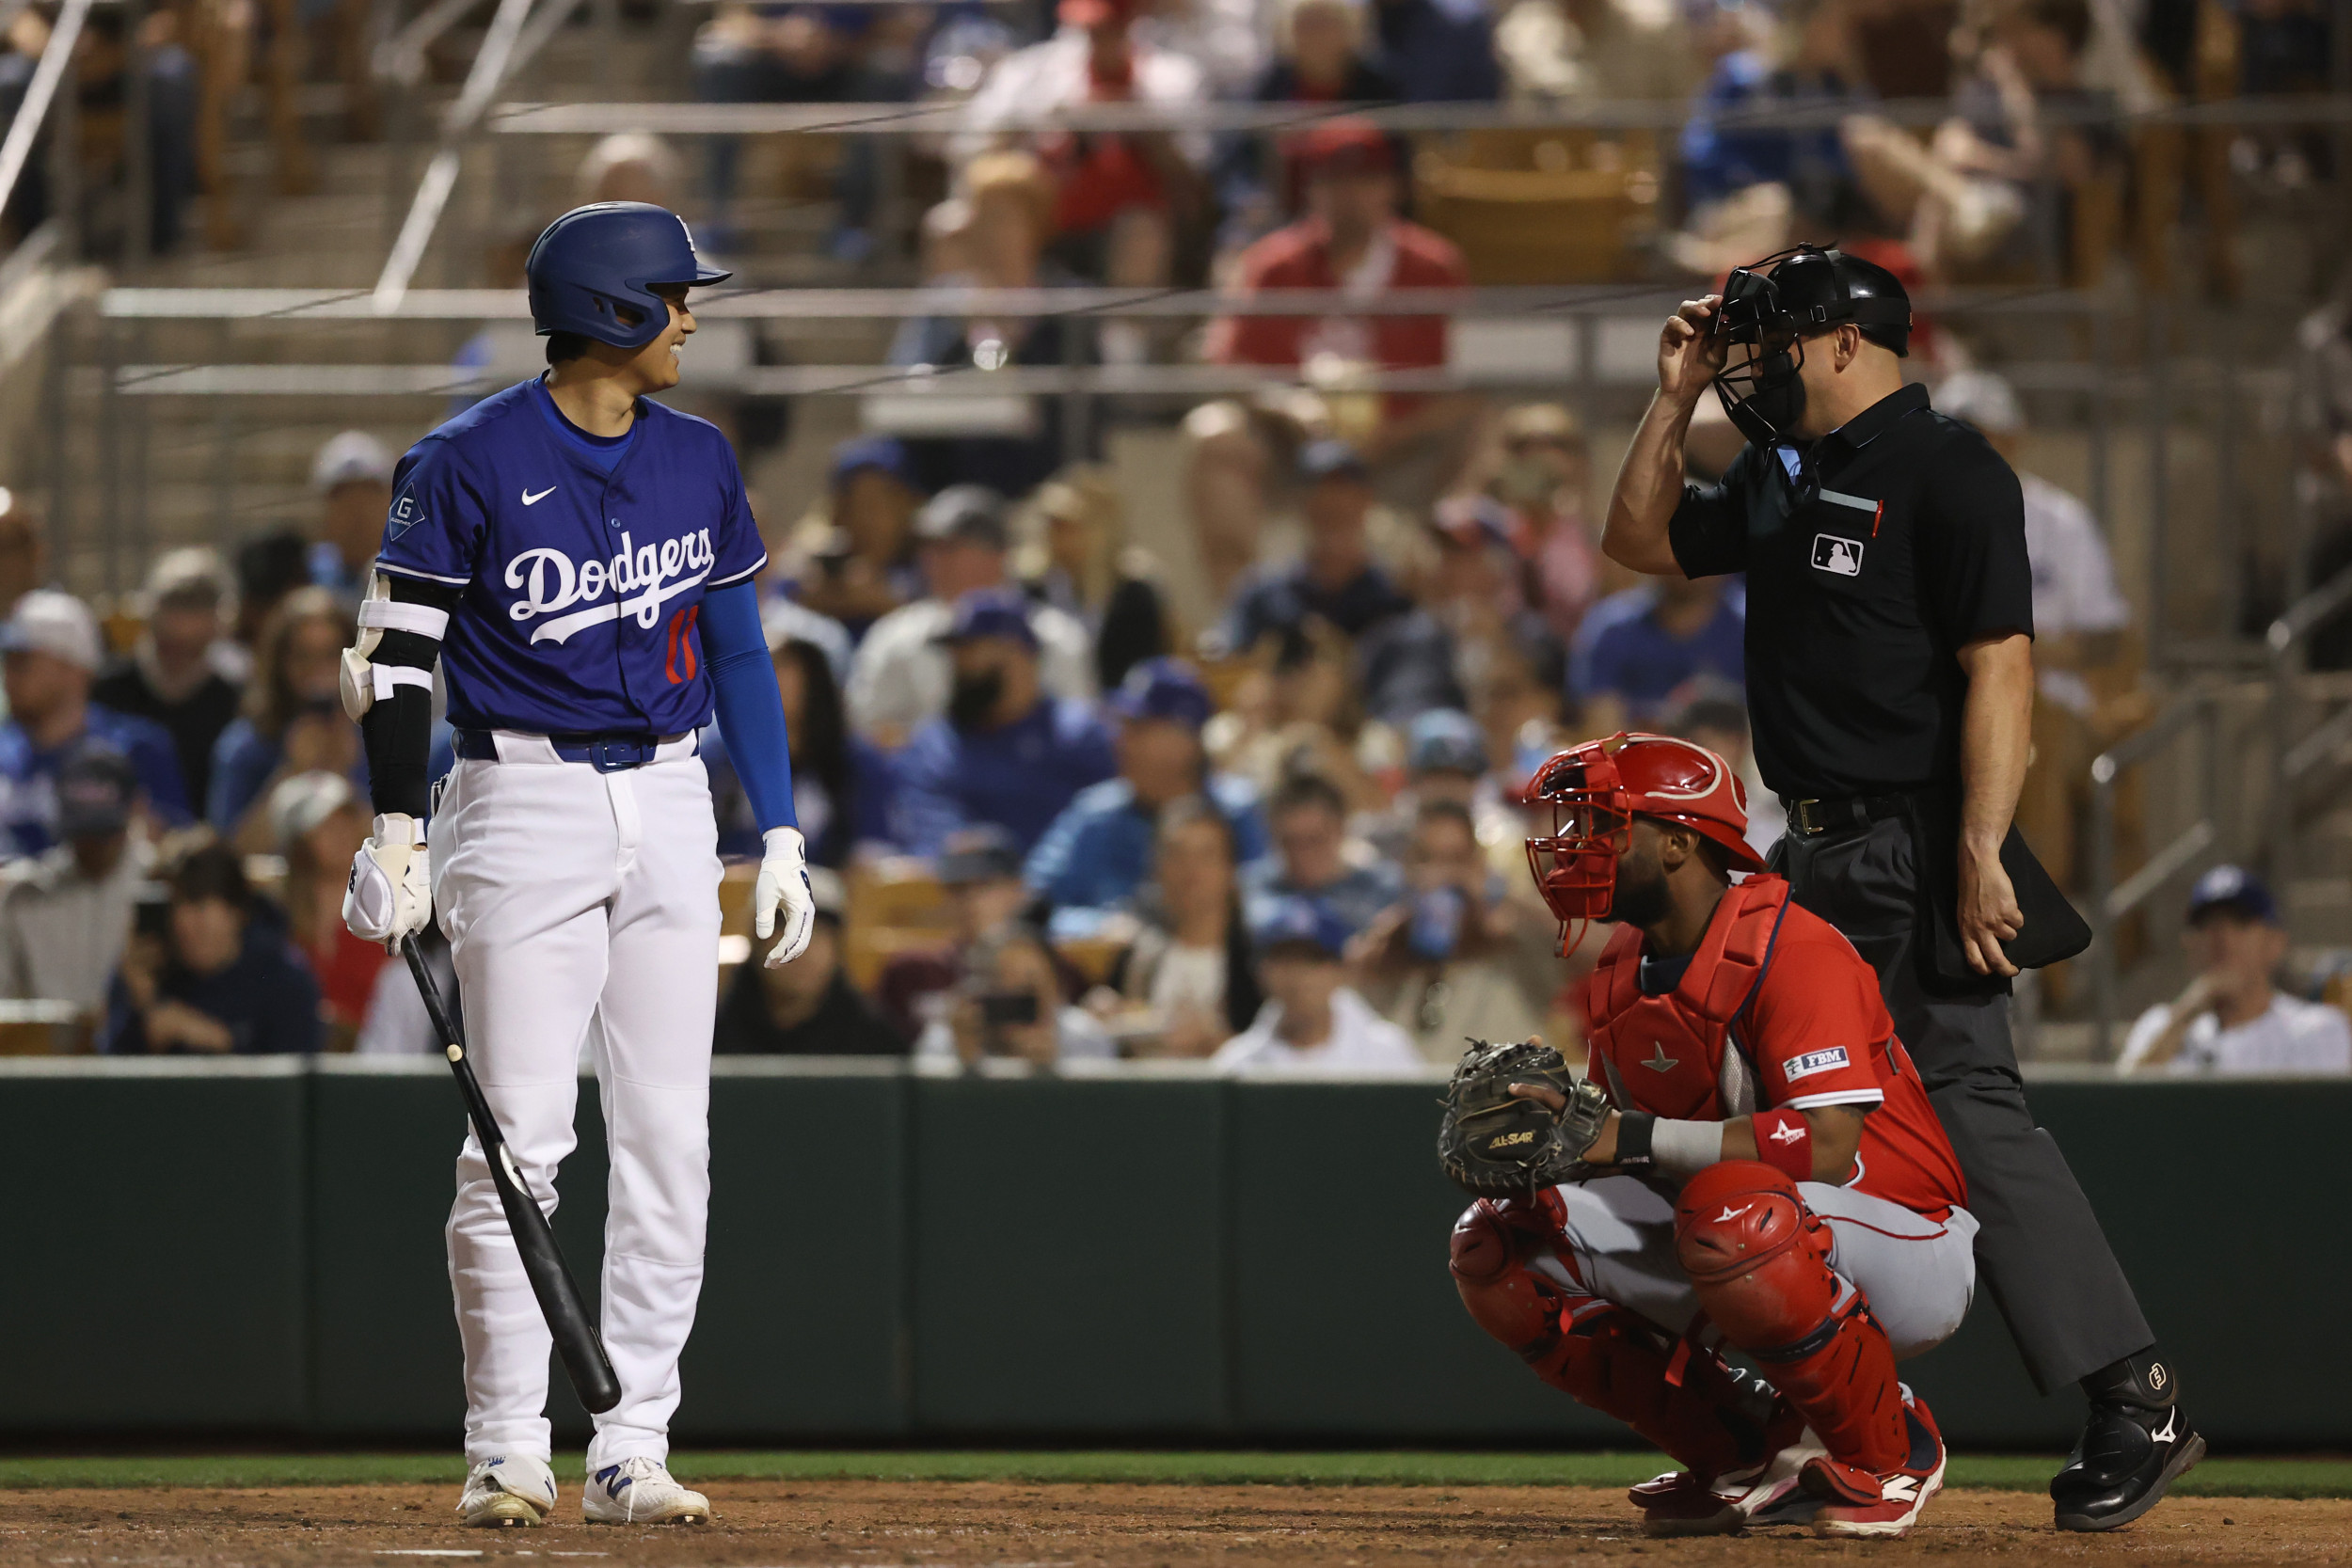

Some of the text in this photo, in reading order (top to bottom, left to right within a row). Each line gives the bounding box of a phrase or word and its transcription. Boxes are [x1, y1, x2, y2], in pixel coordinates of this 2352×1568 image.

[396, 497, 415, 519] G
[504, 527, 713, 630] Dodgers
[664, 604, 699, 685] 11
[1806, 1050, 1842, 1067] FBM
[1488, 1131, 1534, 1149] ALL-STAR
